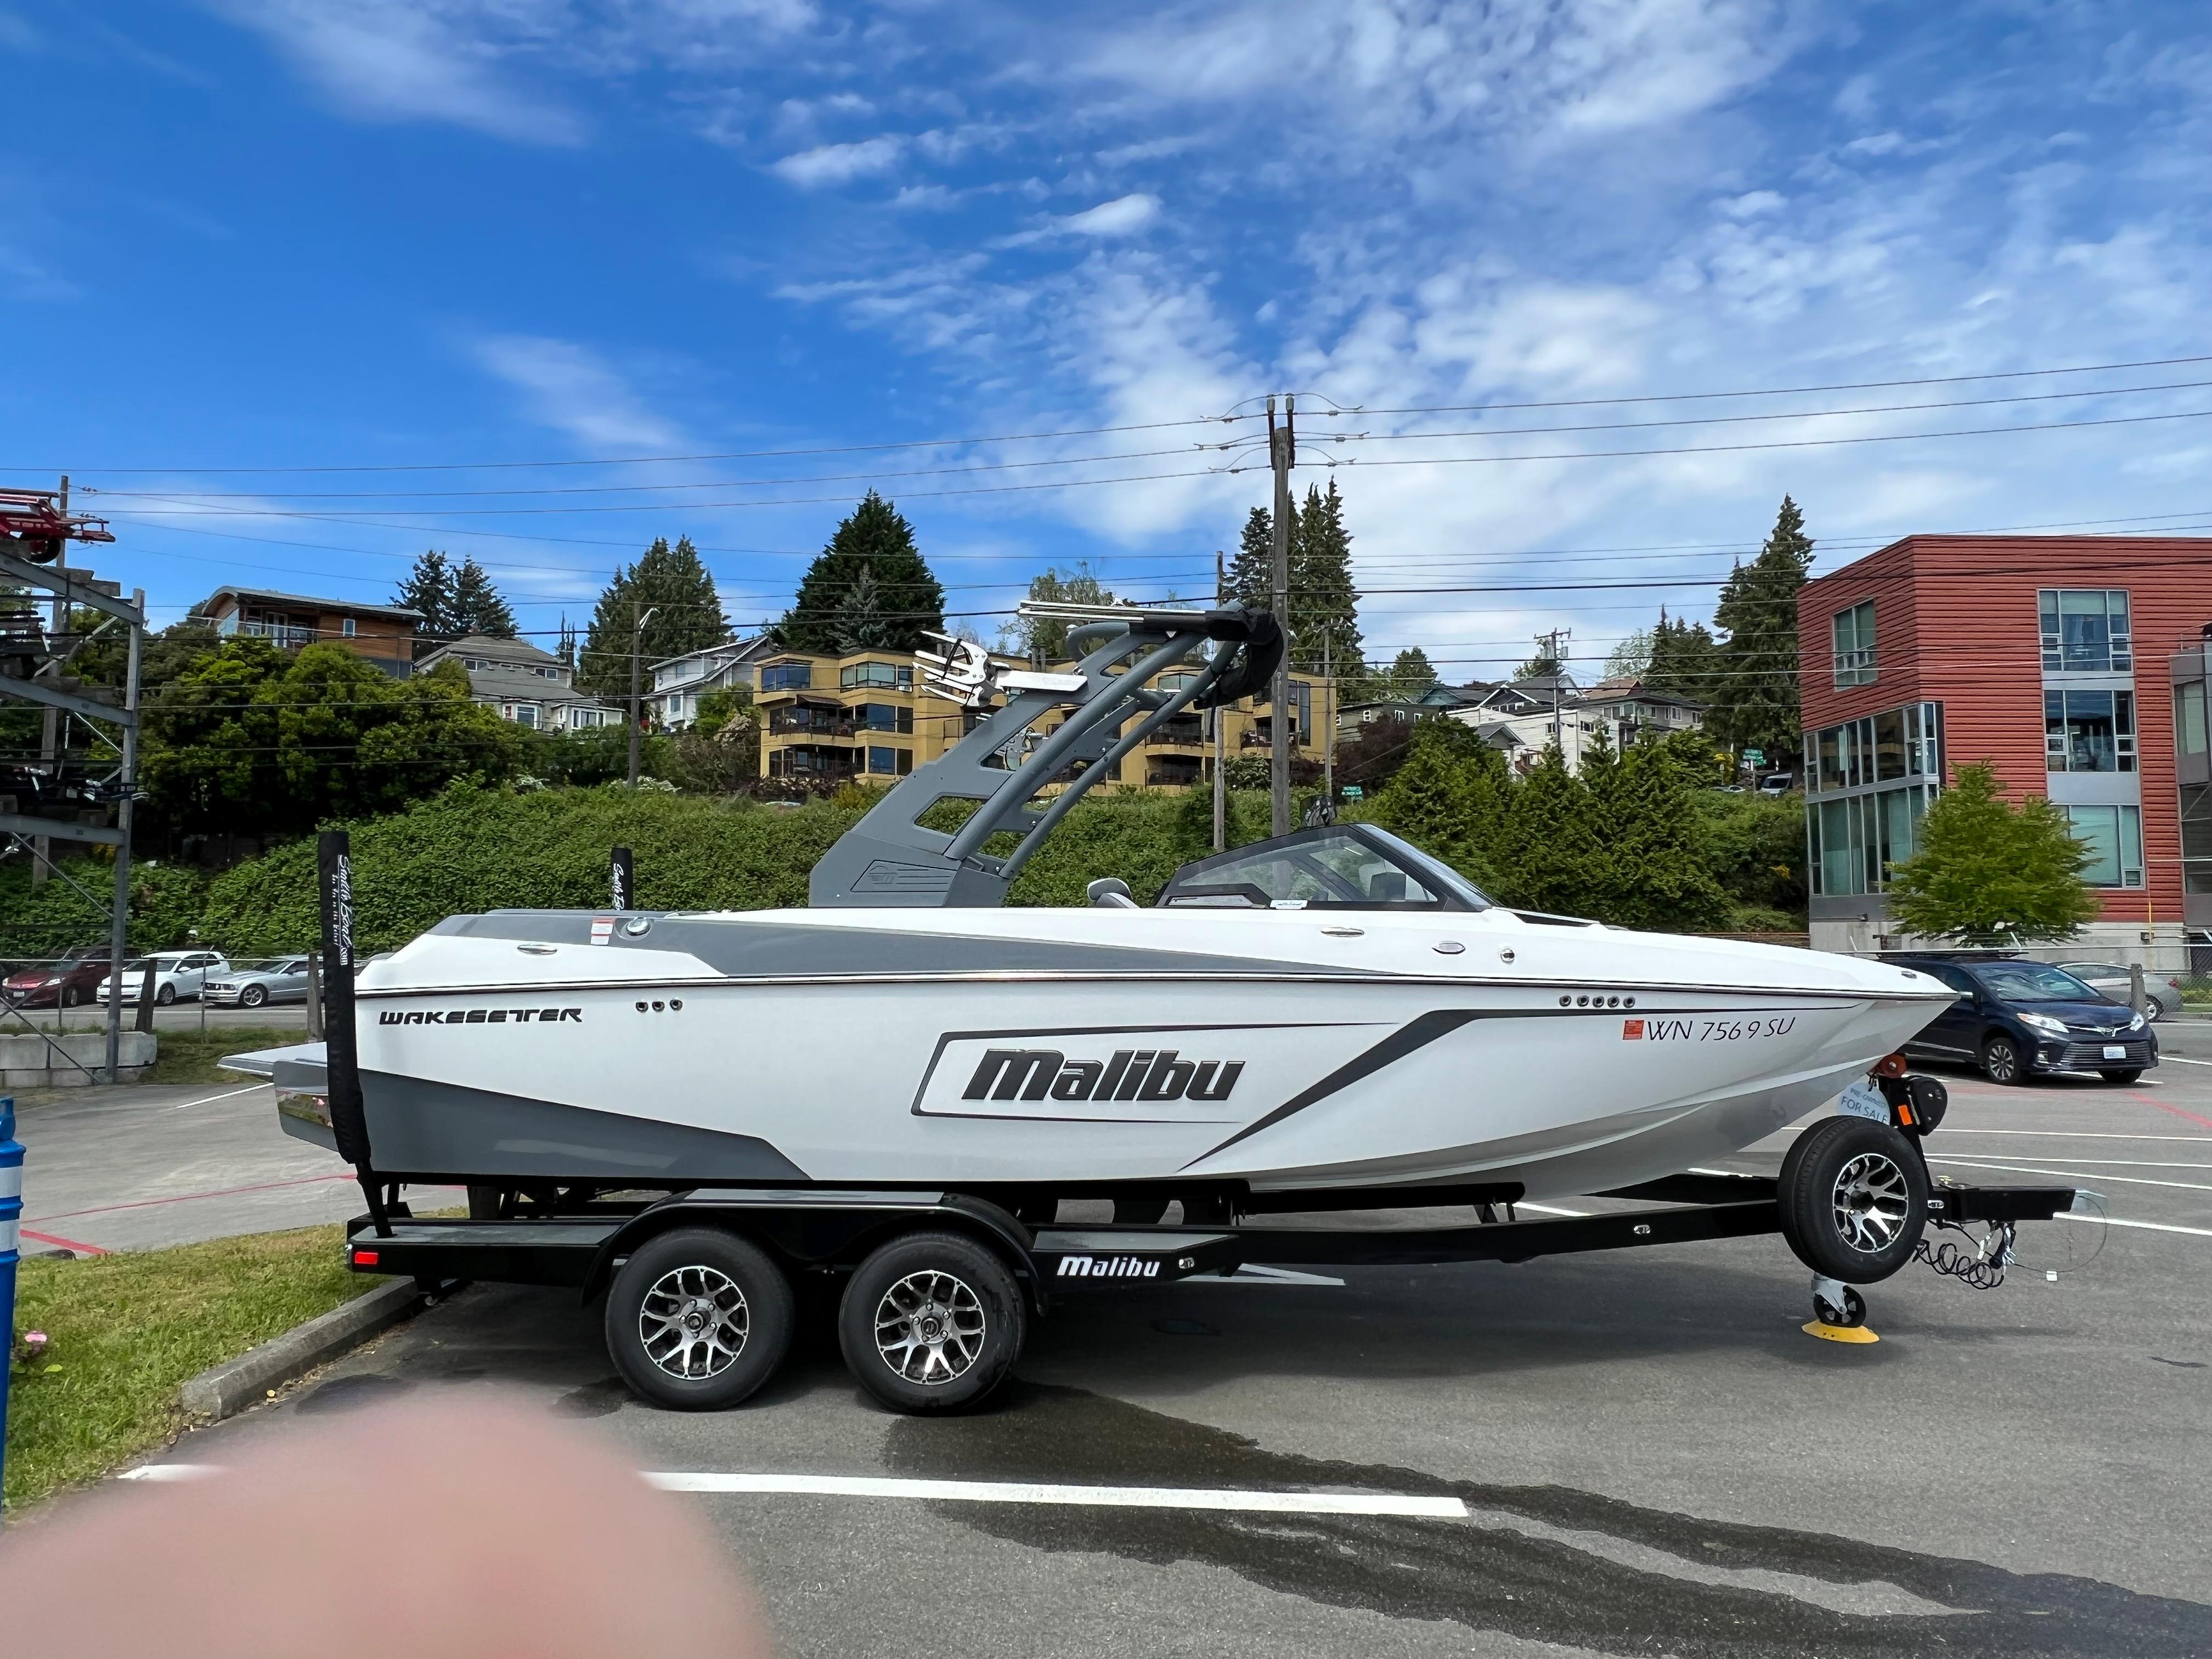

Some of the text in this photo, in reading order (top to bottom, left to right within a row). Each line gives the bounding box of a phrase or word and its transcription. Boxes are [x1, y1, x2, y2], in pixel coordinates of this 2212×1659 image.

[379, 1008, 583, 1025] WAKESETTER
[1647, 1020, 1693, 1041] WN
[1700, 1021, 1760, 1041] 7569
[1763, 1017, 1796, 1037] SU
[961, 1048, 1246, 1101] Malibu
[1841, 1096, 1862, 1113] FOR
[1057, 1256, 1160, 1277] Malibu
